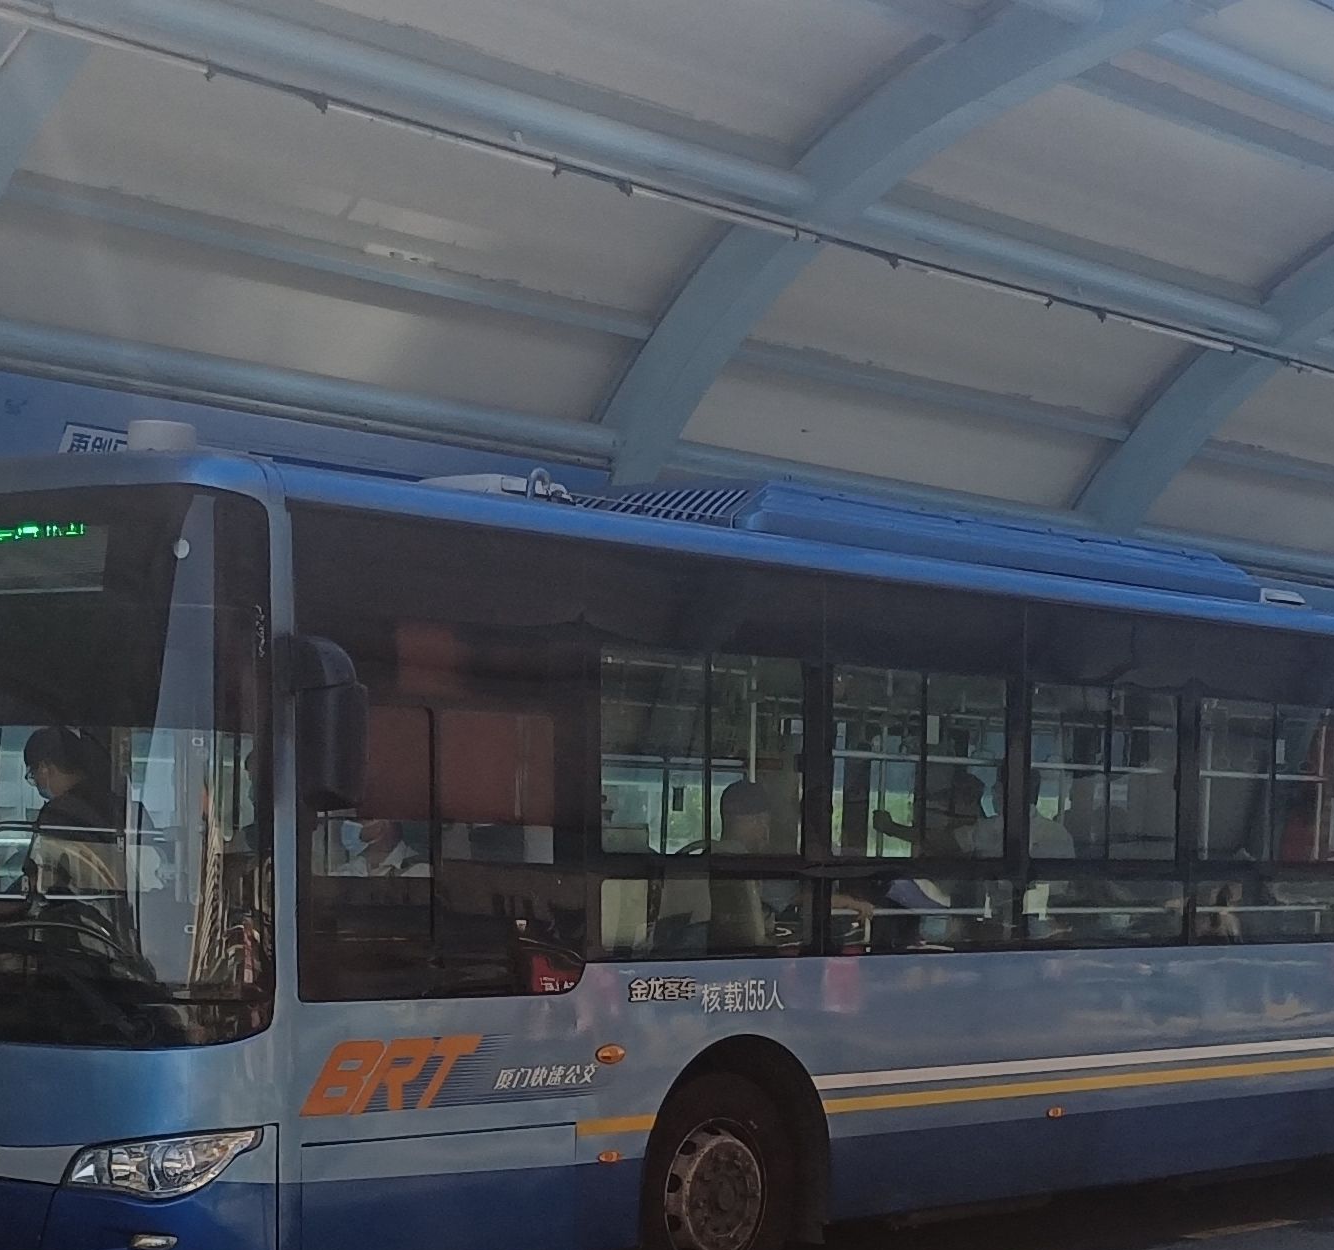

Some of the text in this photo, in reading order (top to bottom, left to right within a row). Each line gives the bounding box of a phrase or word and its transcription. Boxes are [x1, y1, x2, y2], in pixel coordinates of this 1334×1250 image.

[628, 976, 697, 1002] 金龙客车
[701, 979, 785, 1014] 核载155人
[299, 1033, 483, 1118] BRT
[494, 1063, 599, 1090] 厦门快速公交
